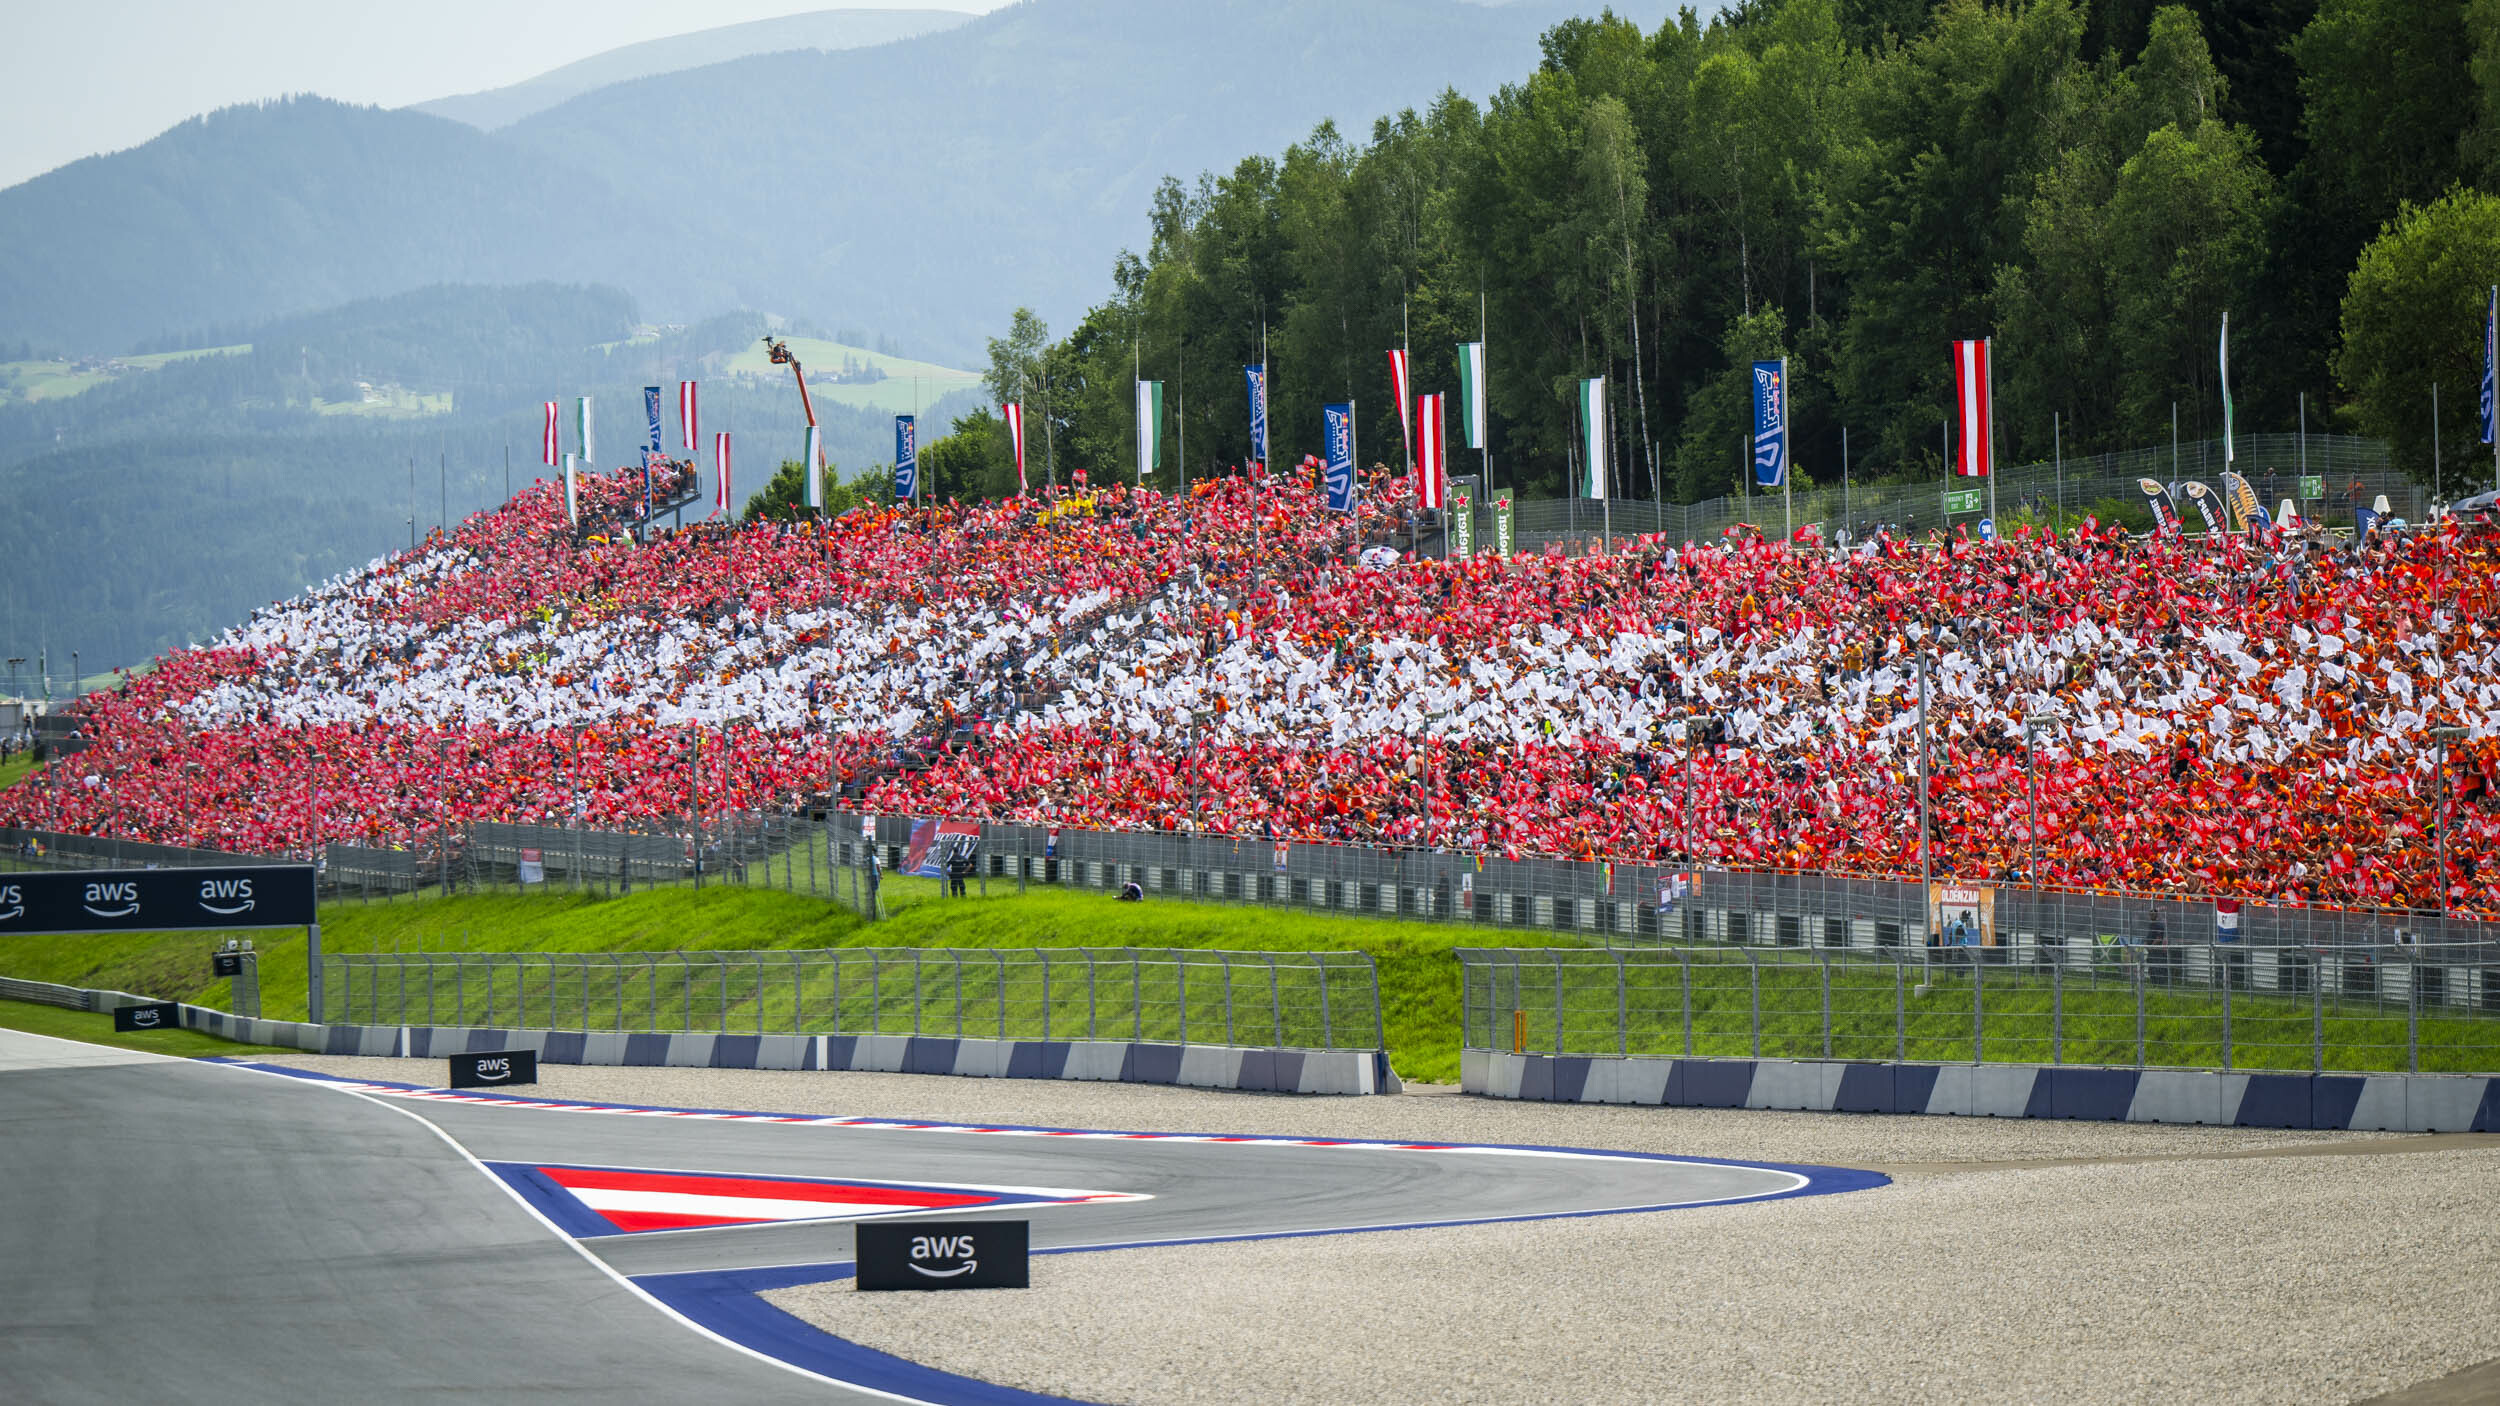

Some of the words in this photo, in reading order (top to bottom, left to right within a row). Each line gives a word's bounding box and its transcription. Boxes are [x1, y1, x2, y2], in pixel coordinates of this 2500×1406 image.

[85, 882, 138, 902] aws
[201, 878, 253, 899] aws
[134, 1009, 159, 1020] aws
[477, 1058, 510, 1072] aws
[911, 1235, 975, 1259] aws
